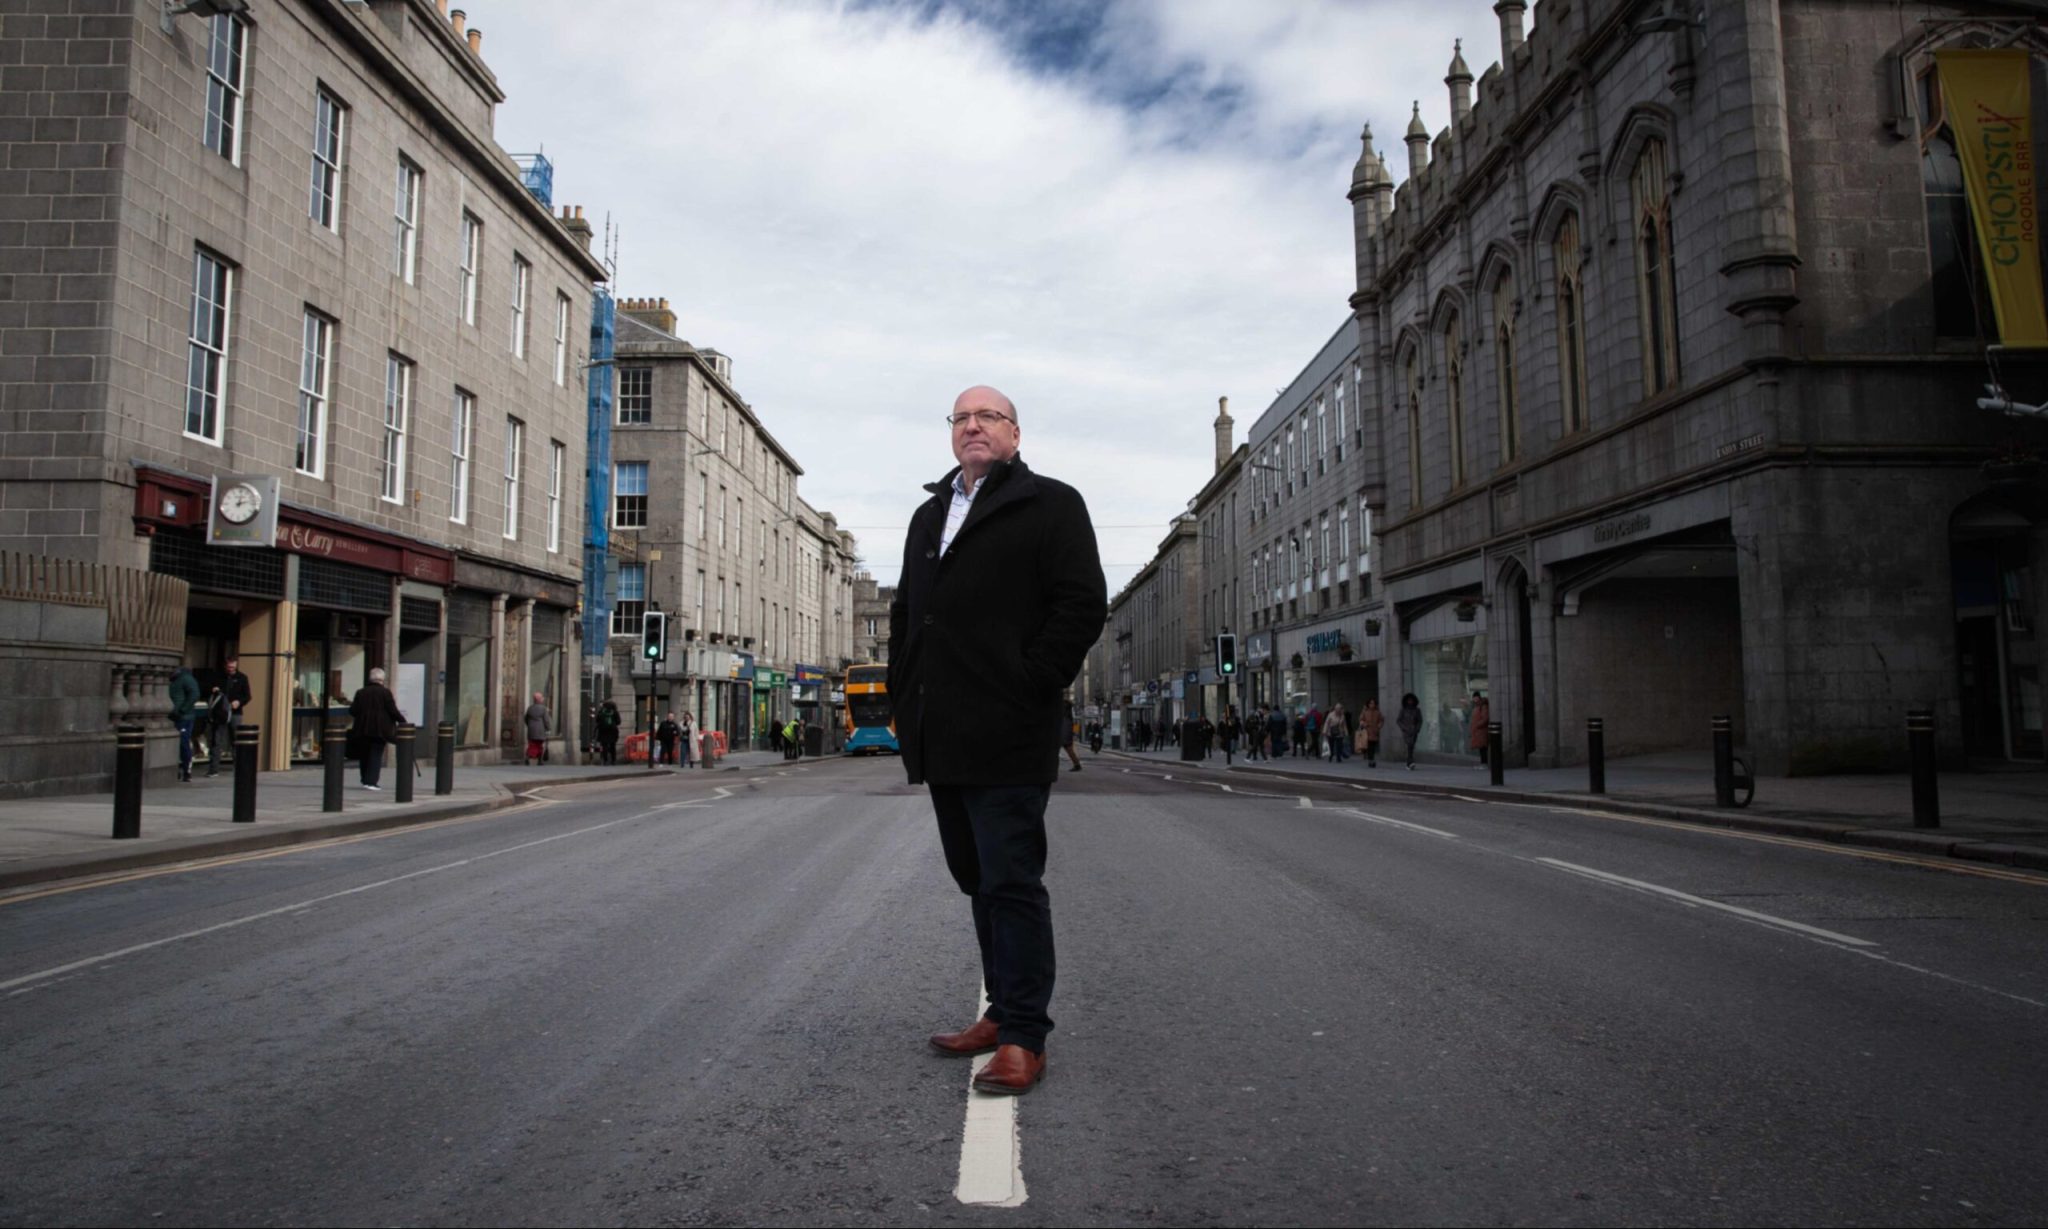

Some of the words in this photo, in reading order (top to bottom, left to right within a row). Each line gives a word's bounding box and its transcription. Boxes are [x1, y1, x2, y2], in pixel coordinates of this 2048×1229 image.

[1976, 99, 2026, 266] CHOPSTIX
[2016, 141, 2031, 171] BAR
[2018, 177, 2033, 242] NOODLE
